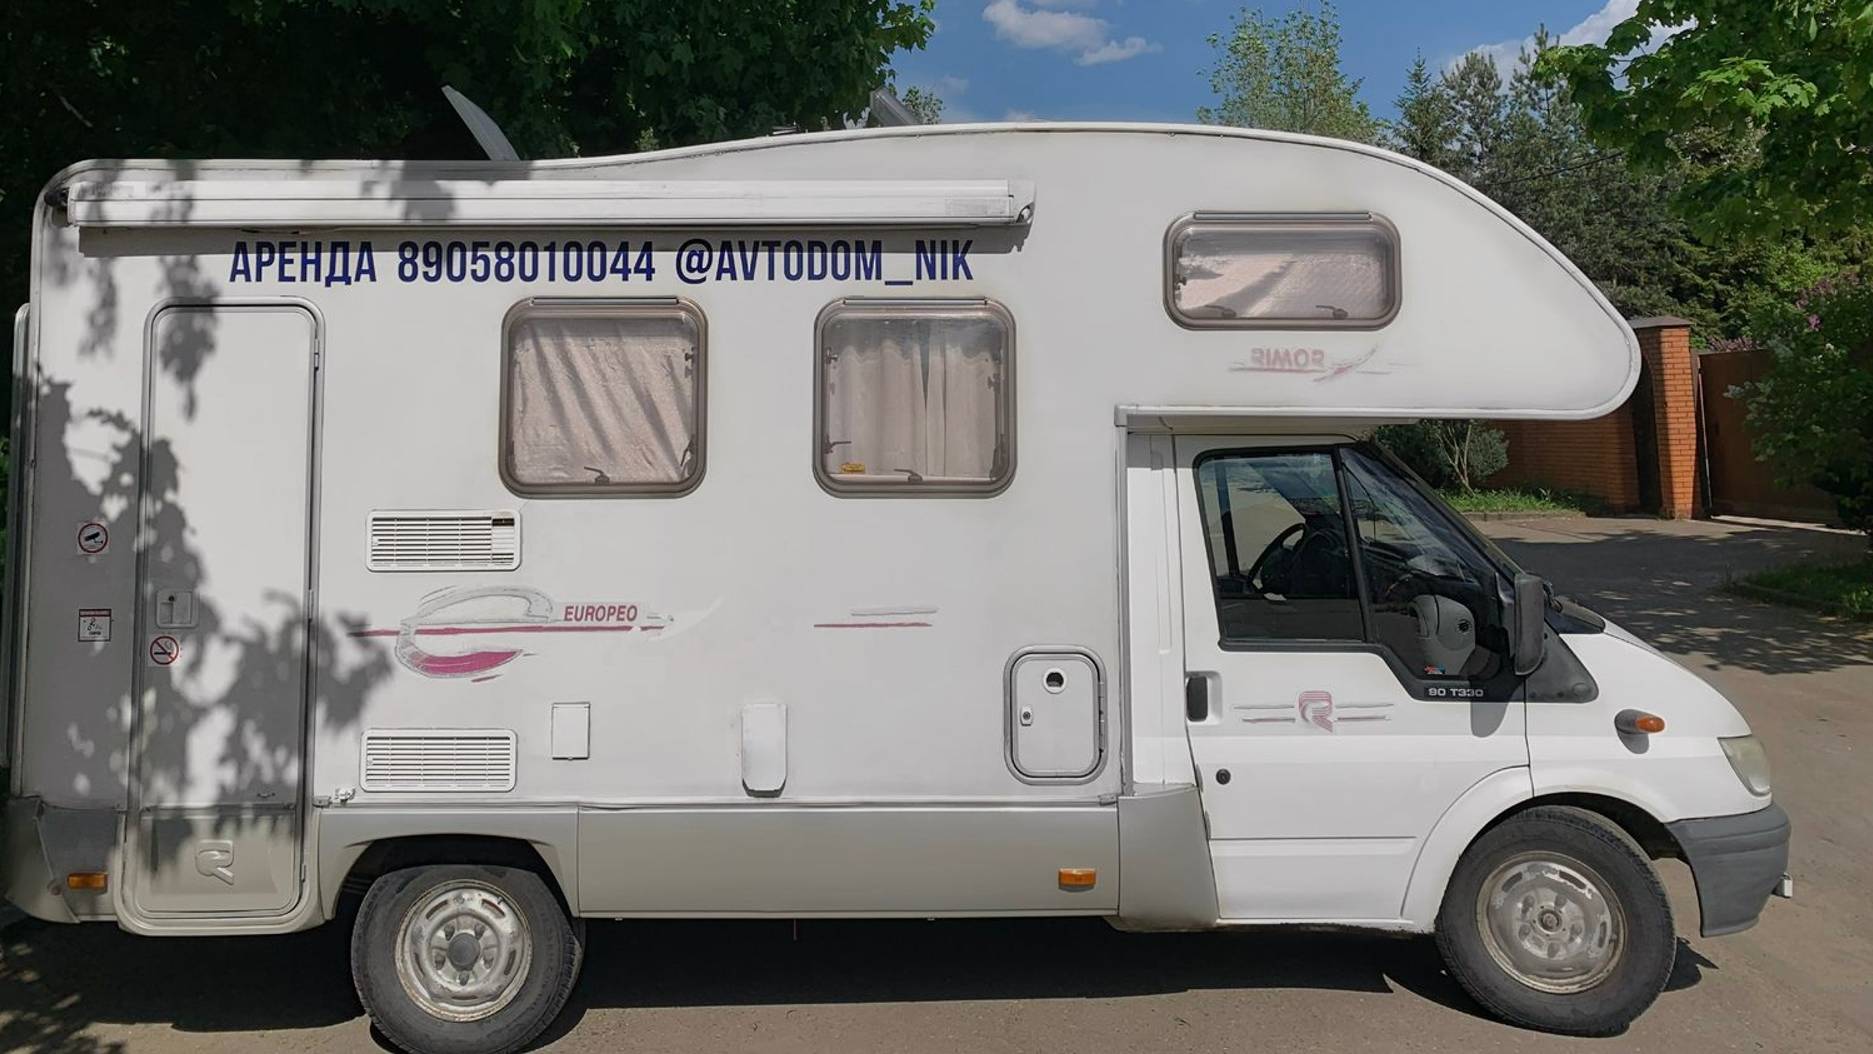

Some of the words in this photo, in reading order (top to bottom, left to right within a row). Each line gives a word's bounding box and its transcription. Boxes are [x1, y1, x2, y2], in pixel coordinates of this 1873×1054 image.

[229, 241, 377, 287] АРЕНДА
[398, 240, 656, 283] 89058010044
[676, 238, 974, 285] @AVTODOM_NIK
[563, 605, 638, 622] EUROPEO
[1428, 687, 1446, 697] 90
[1450, 688, 1484, 698] T330
